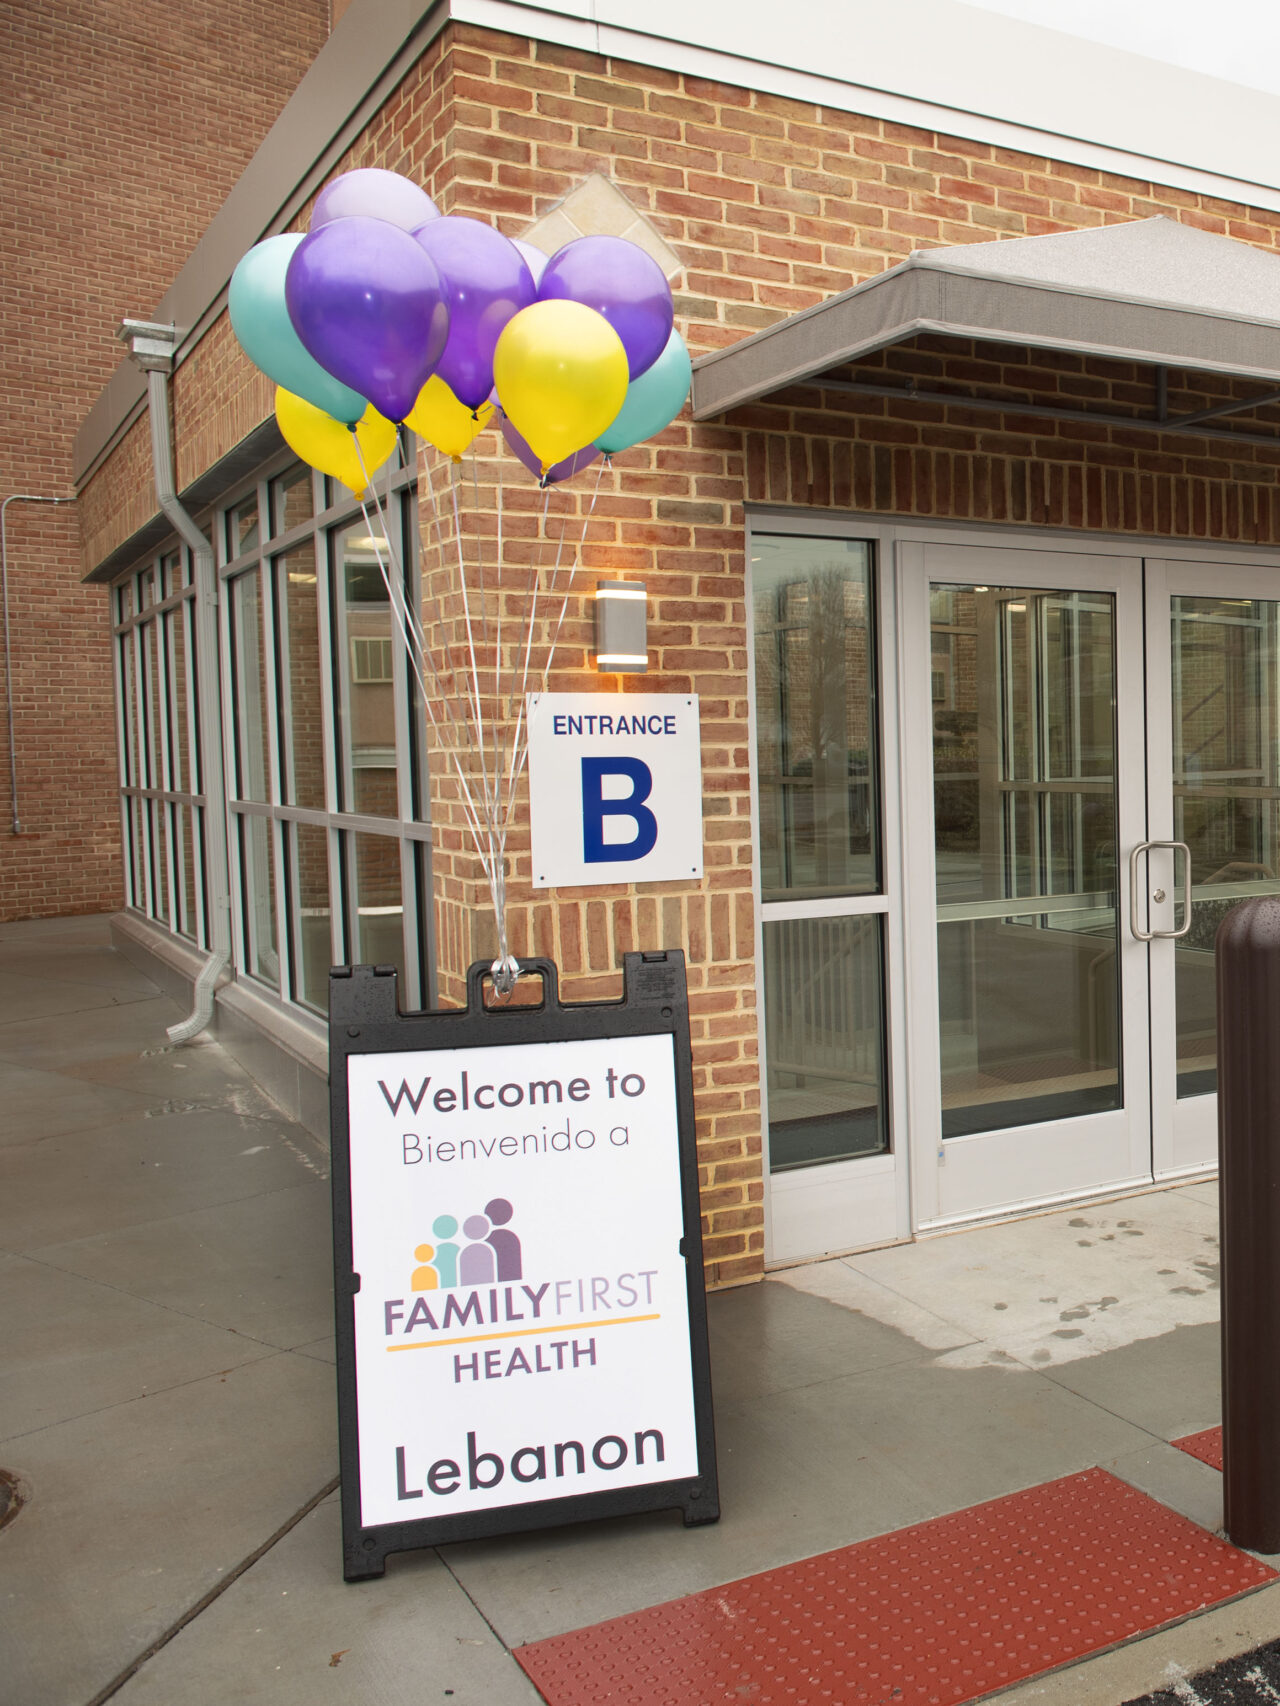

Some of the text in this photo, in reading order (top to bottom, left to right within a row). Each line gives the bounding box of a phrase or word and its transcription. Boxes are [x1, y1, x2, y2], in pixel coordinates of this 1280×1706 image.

[553, 715, 676, 735] ENTRANCE
[581, 756, 658, 863] B
[378, 1068, 645, 1117] Welcome to
[403, 1118, 629, 1164] Bienvenido a
[453, 1338, 597, 1383] HEALTH
[396, 1429, 665, 1500] Lebanon
